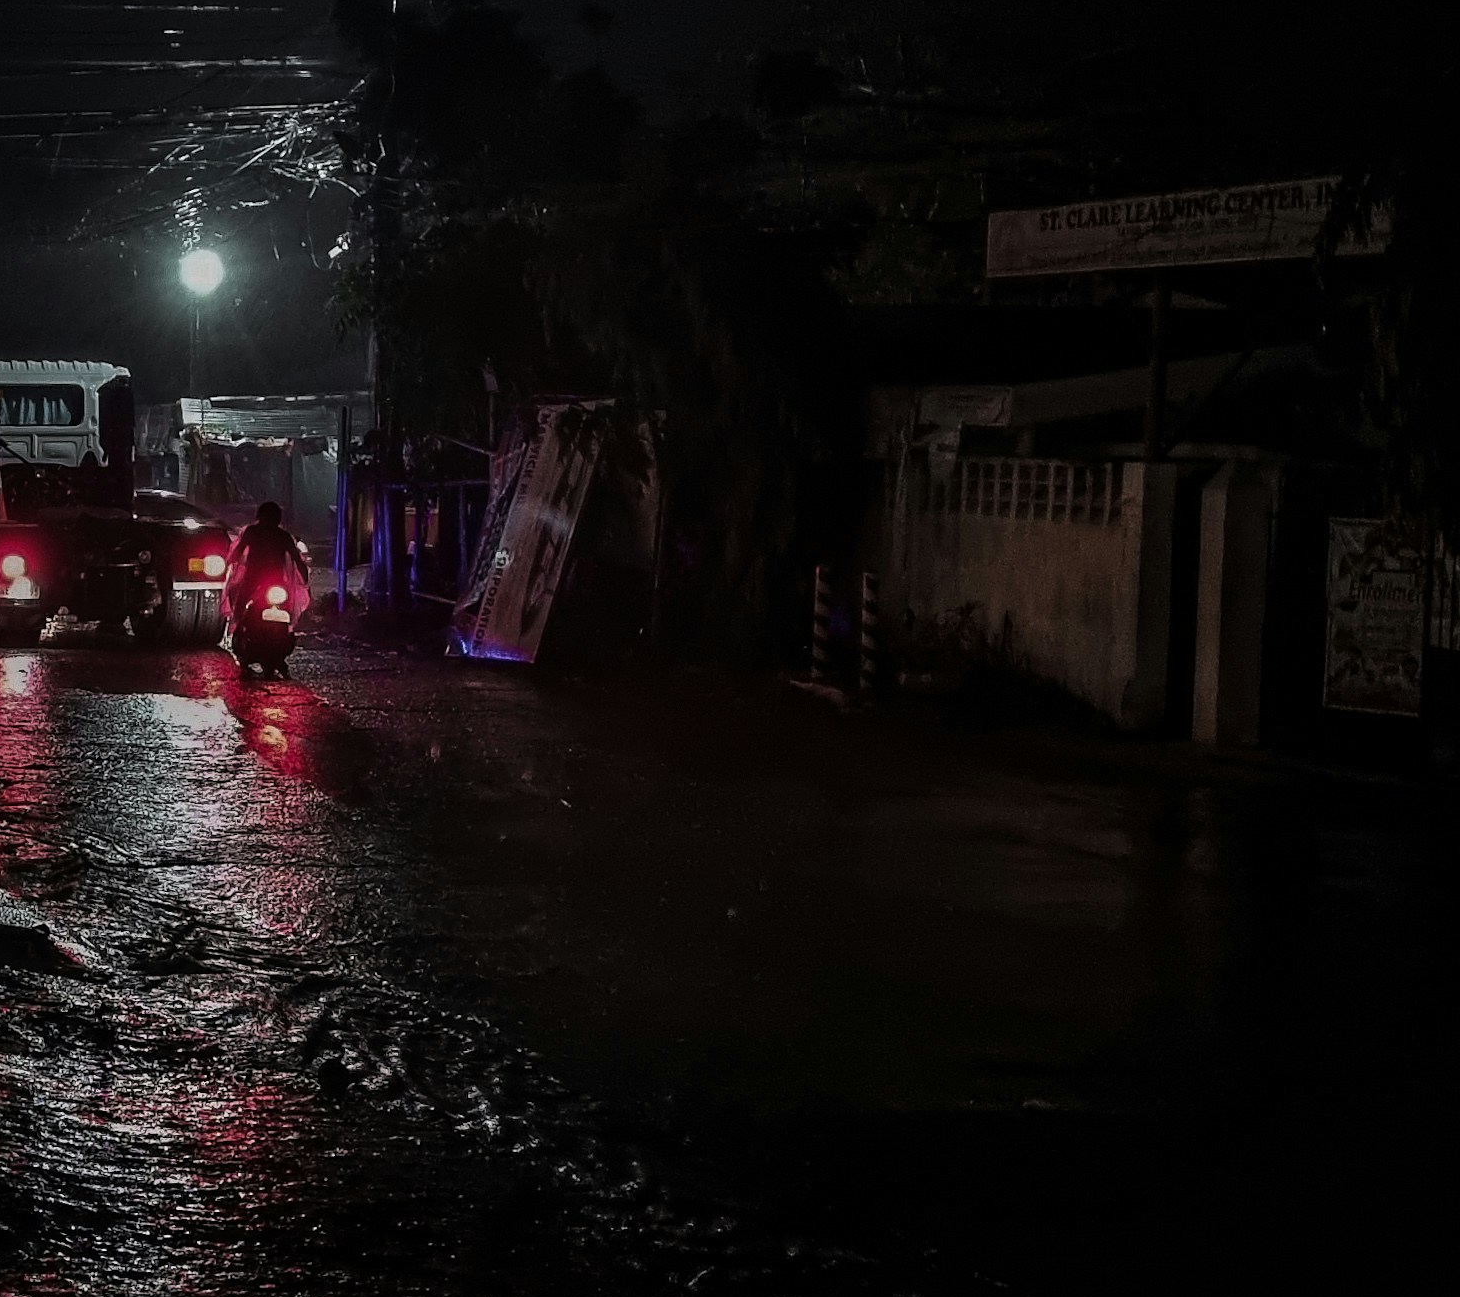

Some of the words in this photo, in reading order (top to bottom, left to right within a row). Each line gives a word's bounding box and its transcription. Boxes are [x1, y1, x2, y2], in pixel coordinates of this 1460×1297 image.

[1040, 210, 1061, 231] ST.
[1066, 204, 1124, 229] CLARE
[1125, 193, 1221, 224] LEARNING
[1224, 184, 1309, 213] CENTER,
[471, 546, 510, 649] CORPORATION
